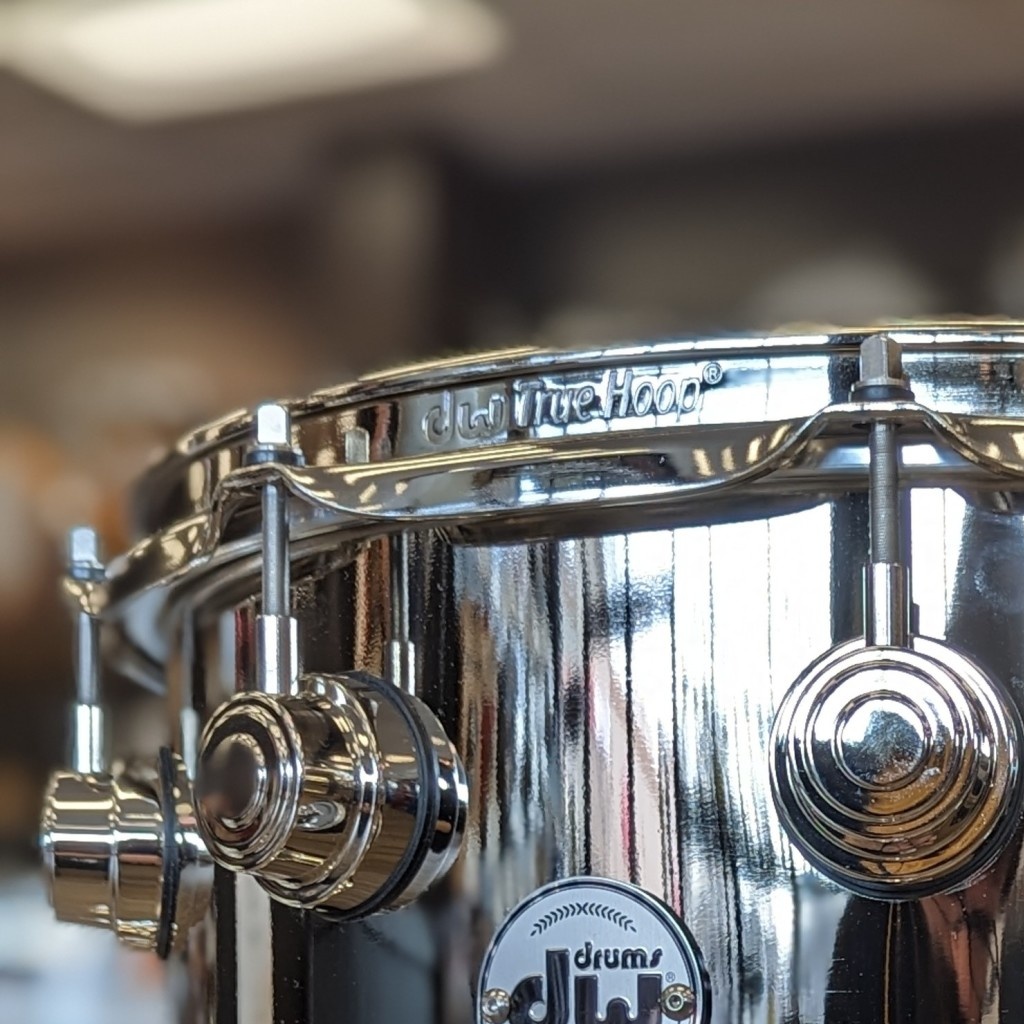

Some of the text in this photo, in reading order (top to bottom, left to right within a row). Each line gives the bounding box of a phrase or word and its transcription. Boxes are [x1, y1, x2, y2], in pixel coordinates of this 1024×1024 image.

[422, 390, 507, 446] dw
[512, 378, 596, 429] True
[574, 941, 663, 970] drums
